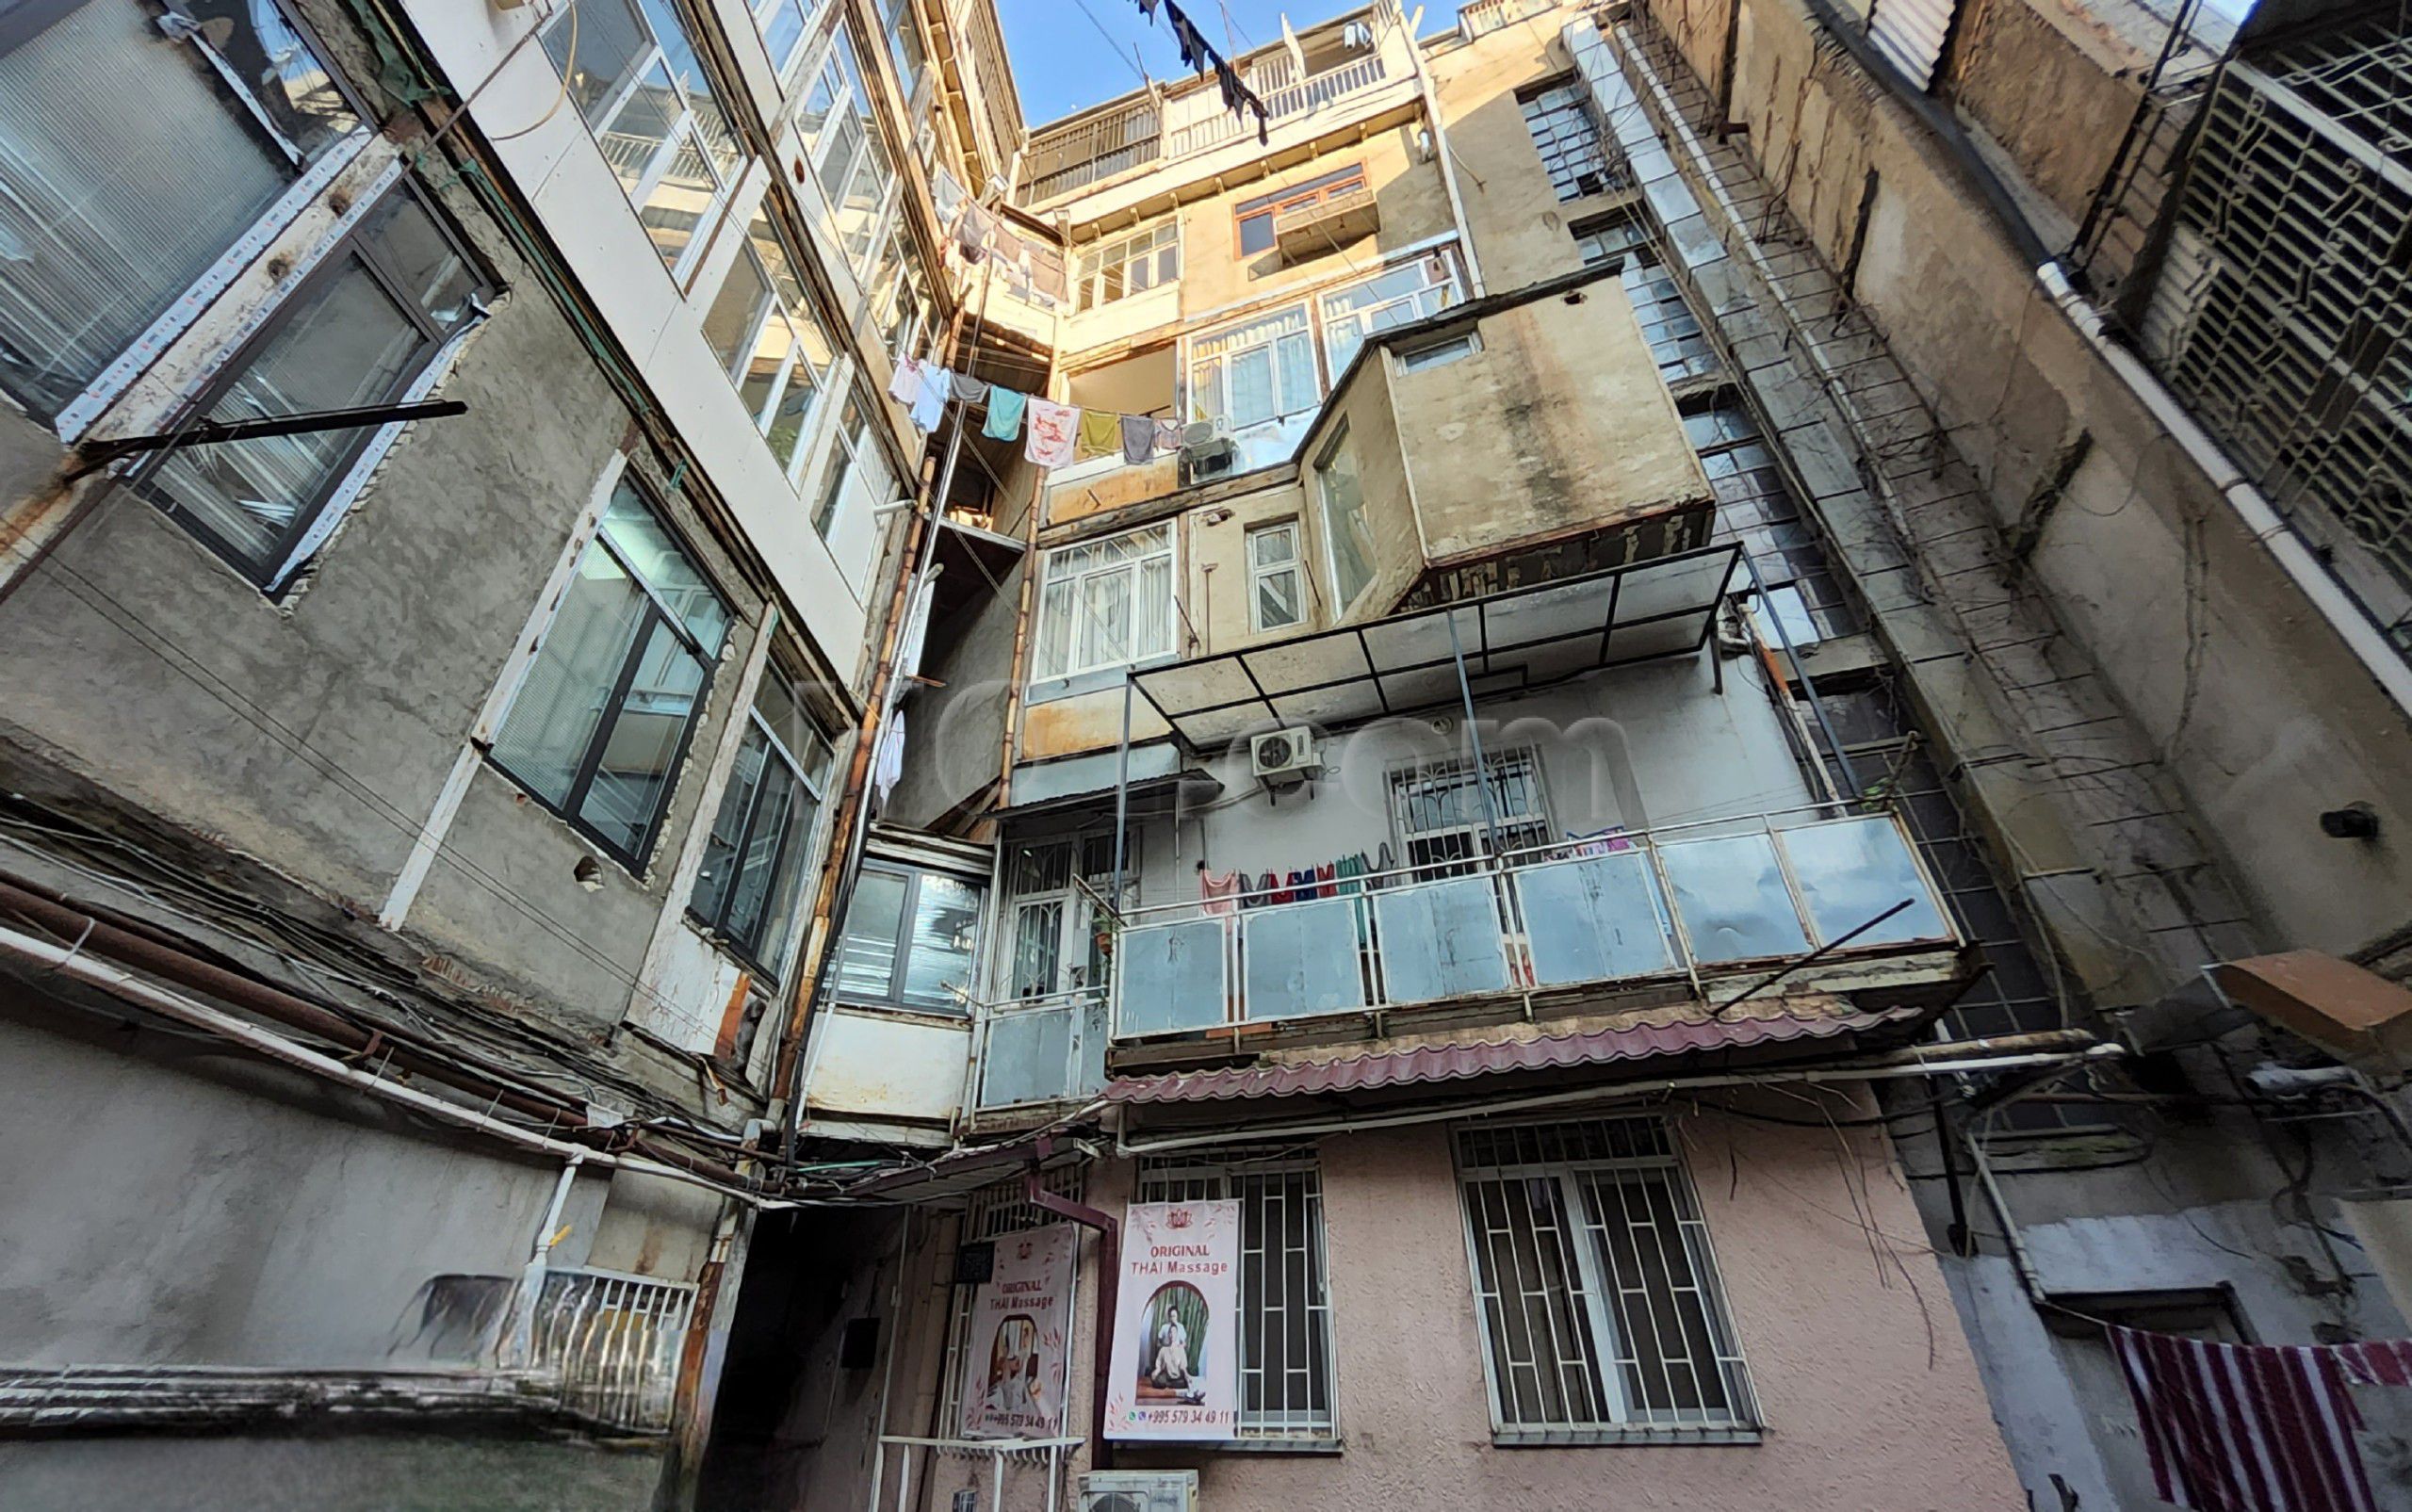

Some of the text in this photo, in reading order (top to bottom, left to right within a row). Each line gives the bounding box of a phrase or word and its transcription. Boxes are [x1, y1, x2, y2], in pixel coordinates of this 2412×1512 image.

[1150, 1244, 1210, 1257] ORIGINAL
[1132, 1261, 1228, 1276] THAI Massage
[1002, 1280, 1042, 1293] ORIGINAL
[990, 1296, 1053, 1310] THAI Massage
[1149, 1410, 1230, 1423] +995 579 34 49 11
